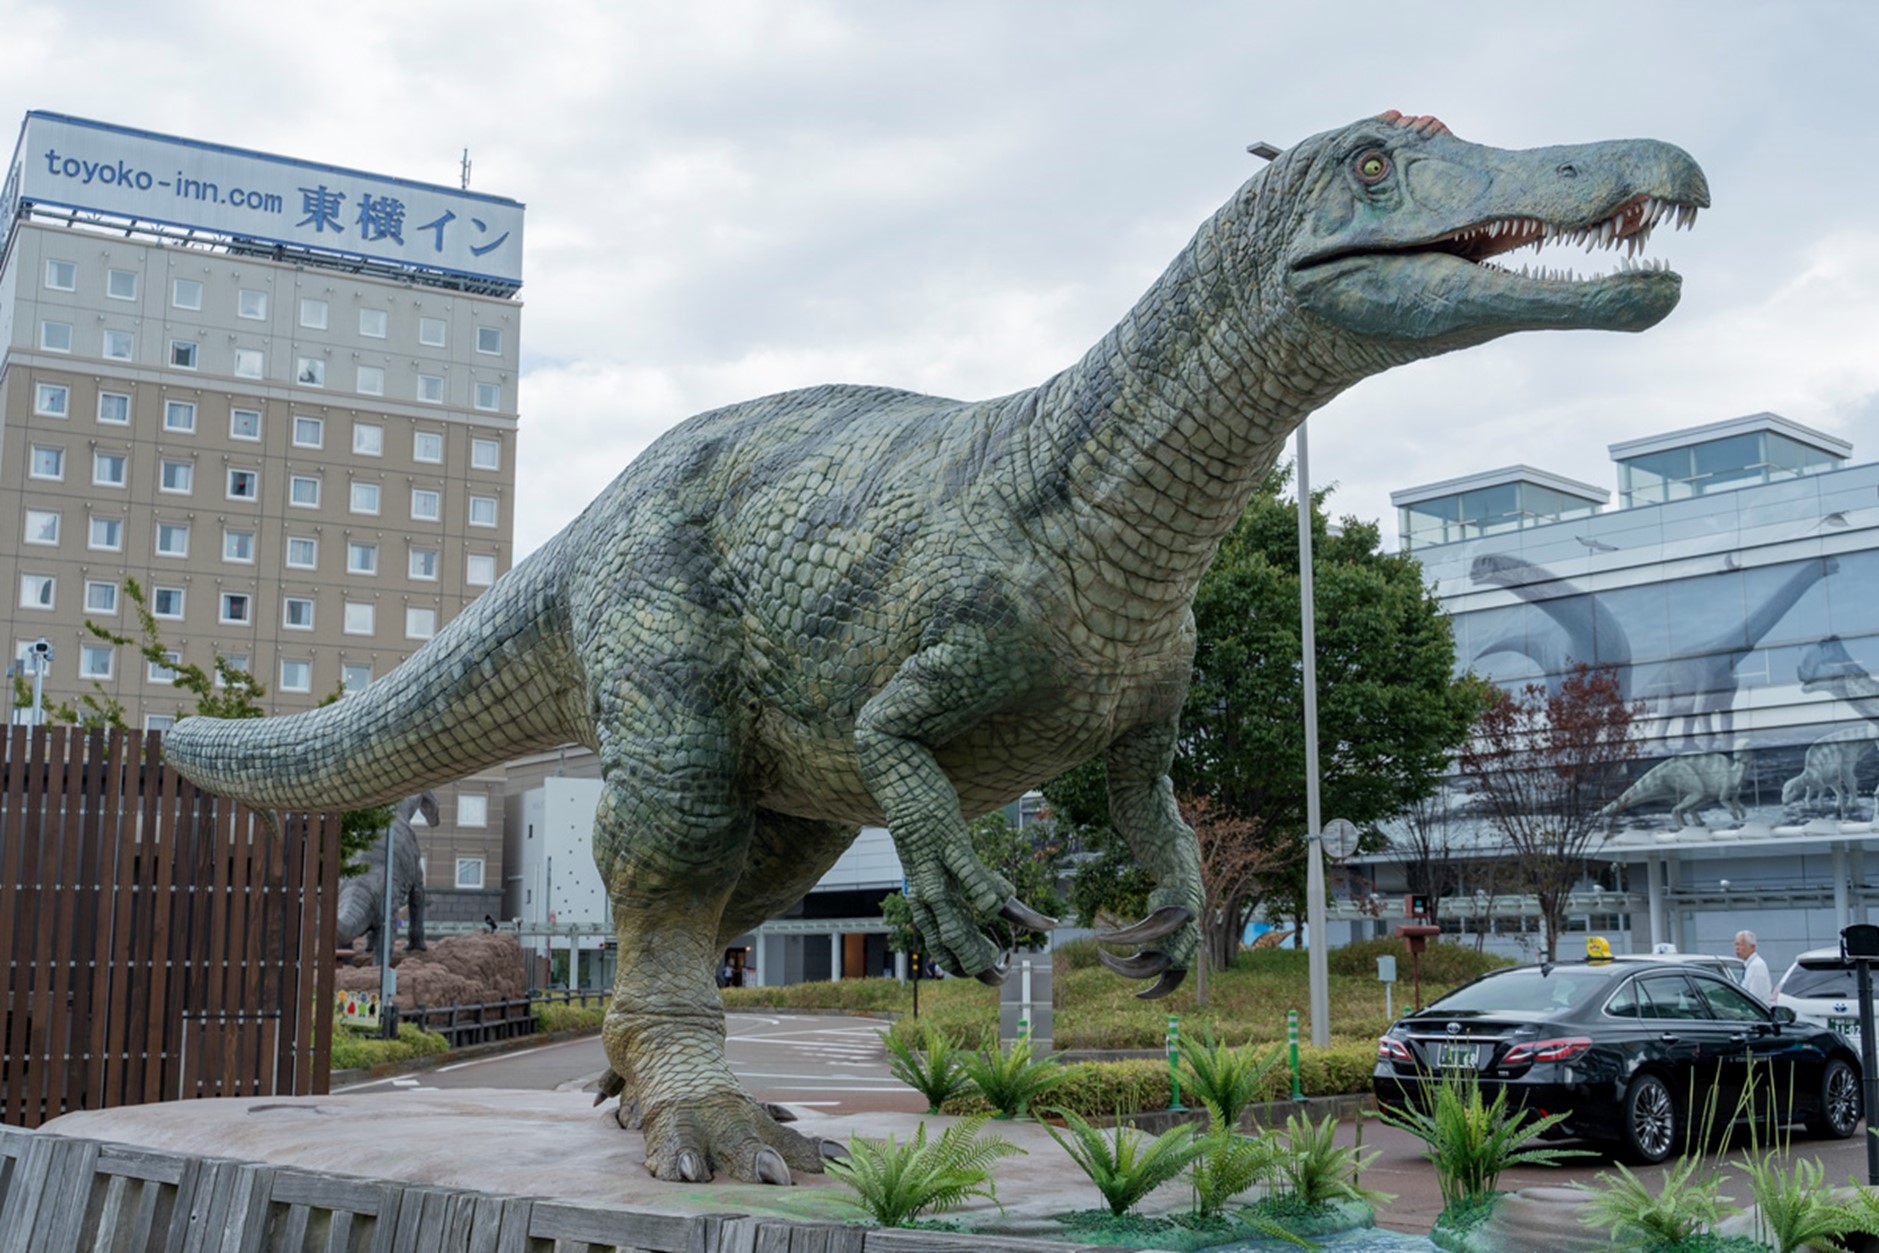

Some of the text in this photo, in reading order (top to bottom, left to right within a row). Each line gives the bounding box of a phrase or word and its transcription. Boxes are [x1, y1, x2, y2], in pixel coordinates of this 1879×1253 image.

[45, 149, 283, 214] toyoko-inn.com
[295, 184, 510, 257] 東横イン
